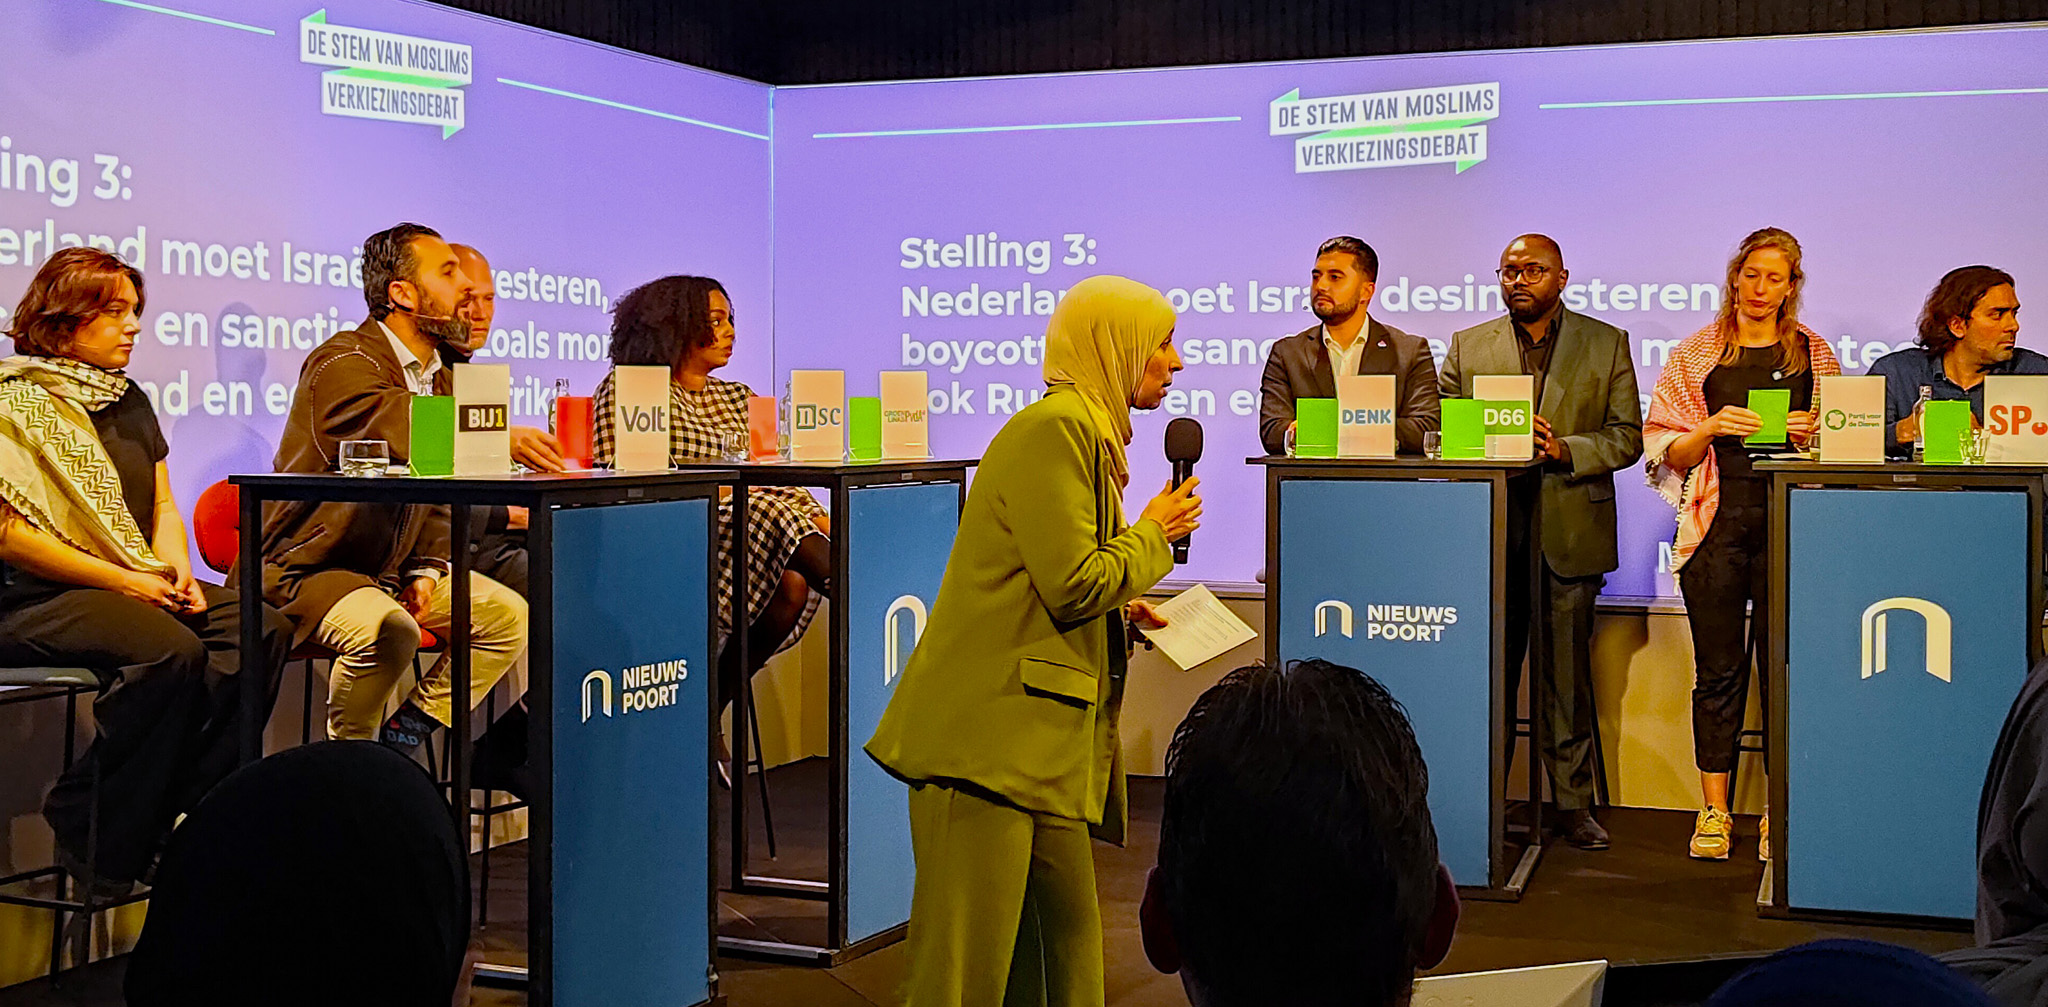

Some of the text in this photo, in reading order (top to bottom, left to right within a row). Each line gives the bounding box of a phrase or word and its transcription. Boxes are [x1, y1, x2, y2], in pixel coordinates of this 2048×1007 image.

[307, 29, 469, 75] DE STEM VAN MOSLIMS
[327, 81, 459, 120] VERKIEZINGSDEBAT
[1278, 88, 1494, 128] DE STEM VAN MOSLIMS
[1301, 132, 1479, 166] VERKIEZINGSDEBAT
[93, 153, 132, 200] 3:
[900, 231, 1097, 274] Stelling 3:
[161, 239, 270, 281] moet
[491, 266, 608, 314] esteren,
[902, 282, 1067, 317] Nederla
[1167, 282, 1235, 313] oet
[154, 311, 208, 346] en
[203, 381, 253, 416] en
[928, 381, 975, 415] ok
[467, 407, 505, 428] BIJ1
[620, 405, 667, 433] Volt
[1341, 409, 1392, 425] DENK
[1483, 407, 1526, 427] D66
[1367, 604, 1458, 625] NIEUWS
[1367, 622, 1446, 642] POORT
[622, 659, 688, 690] NIEUWS
[622, 683, 679, 714] POORT
